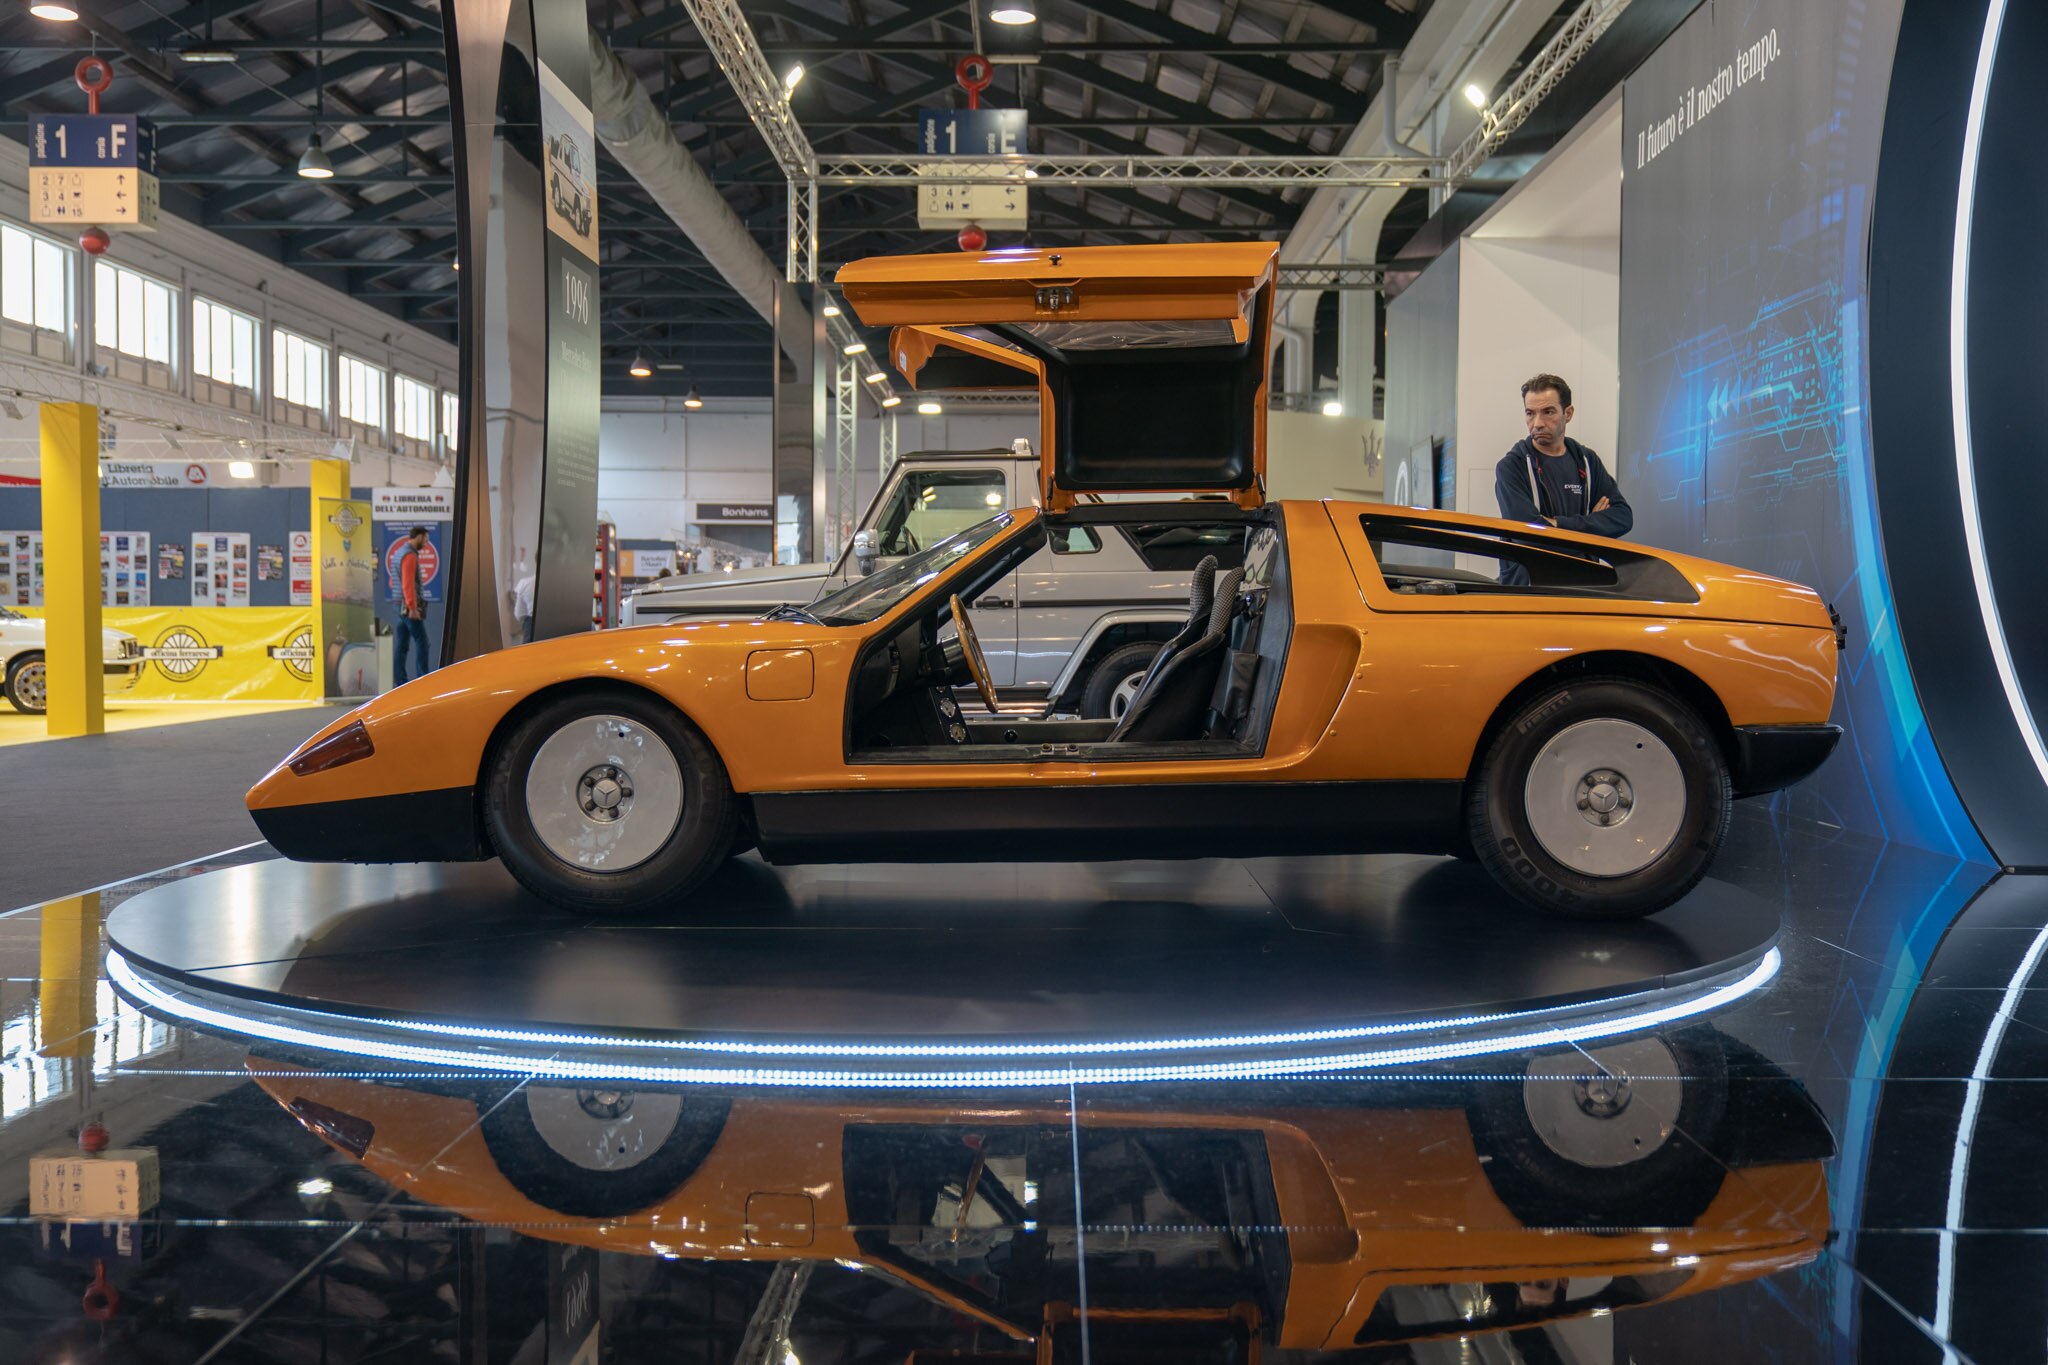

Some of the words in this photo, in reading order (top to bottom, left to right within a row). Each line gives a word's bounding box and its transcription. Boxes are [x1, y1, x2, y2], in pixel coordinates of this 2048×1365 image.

[1637, 131, 1645, 170] Il
[1647, 114, 1676, 163] futuro
[1678, 96, 1684, 135] è
[1686, 87, 1694, 129] il
[1697, 64, 1733, 121] nostro
[1736, 28, 1781, 88] tempo.
[55, 124, 67, 158] 1
[111, 124, 127, 158] F
[945, 120, 957, 154] 1
[42, 175, 49, 186] 2
[58, 175, 64, 185] 7
[43, 192, 49, 201] 3
[58, 192, 65, 201] 4
[931, 188, 938, 197] 3
[947, 188, 953, 197] 4
[565, 271, 589, 325] 1996
[107, 463, 153, 474] Libreria
[394, 495, 432, 503] LIBRERIA
[375, 505, 451, 513] DELL'AUTOMOBILE
[722, 507, 769, 517] Bonhams
